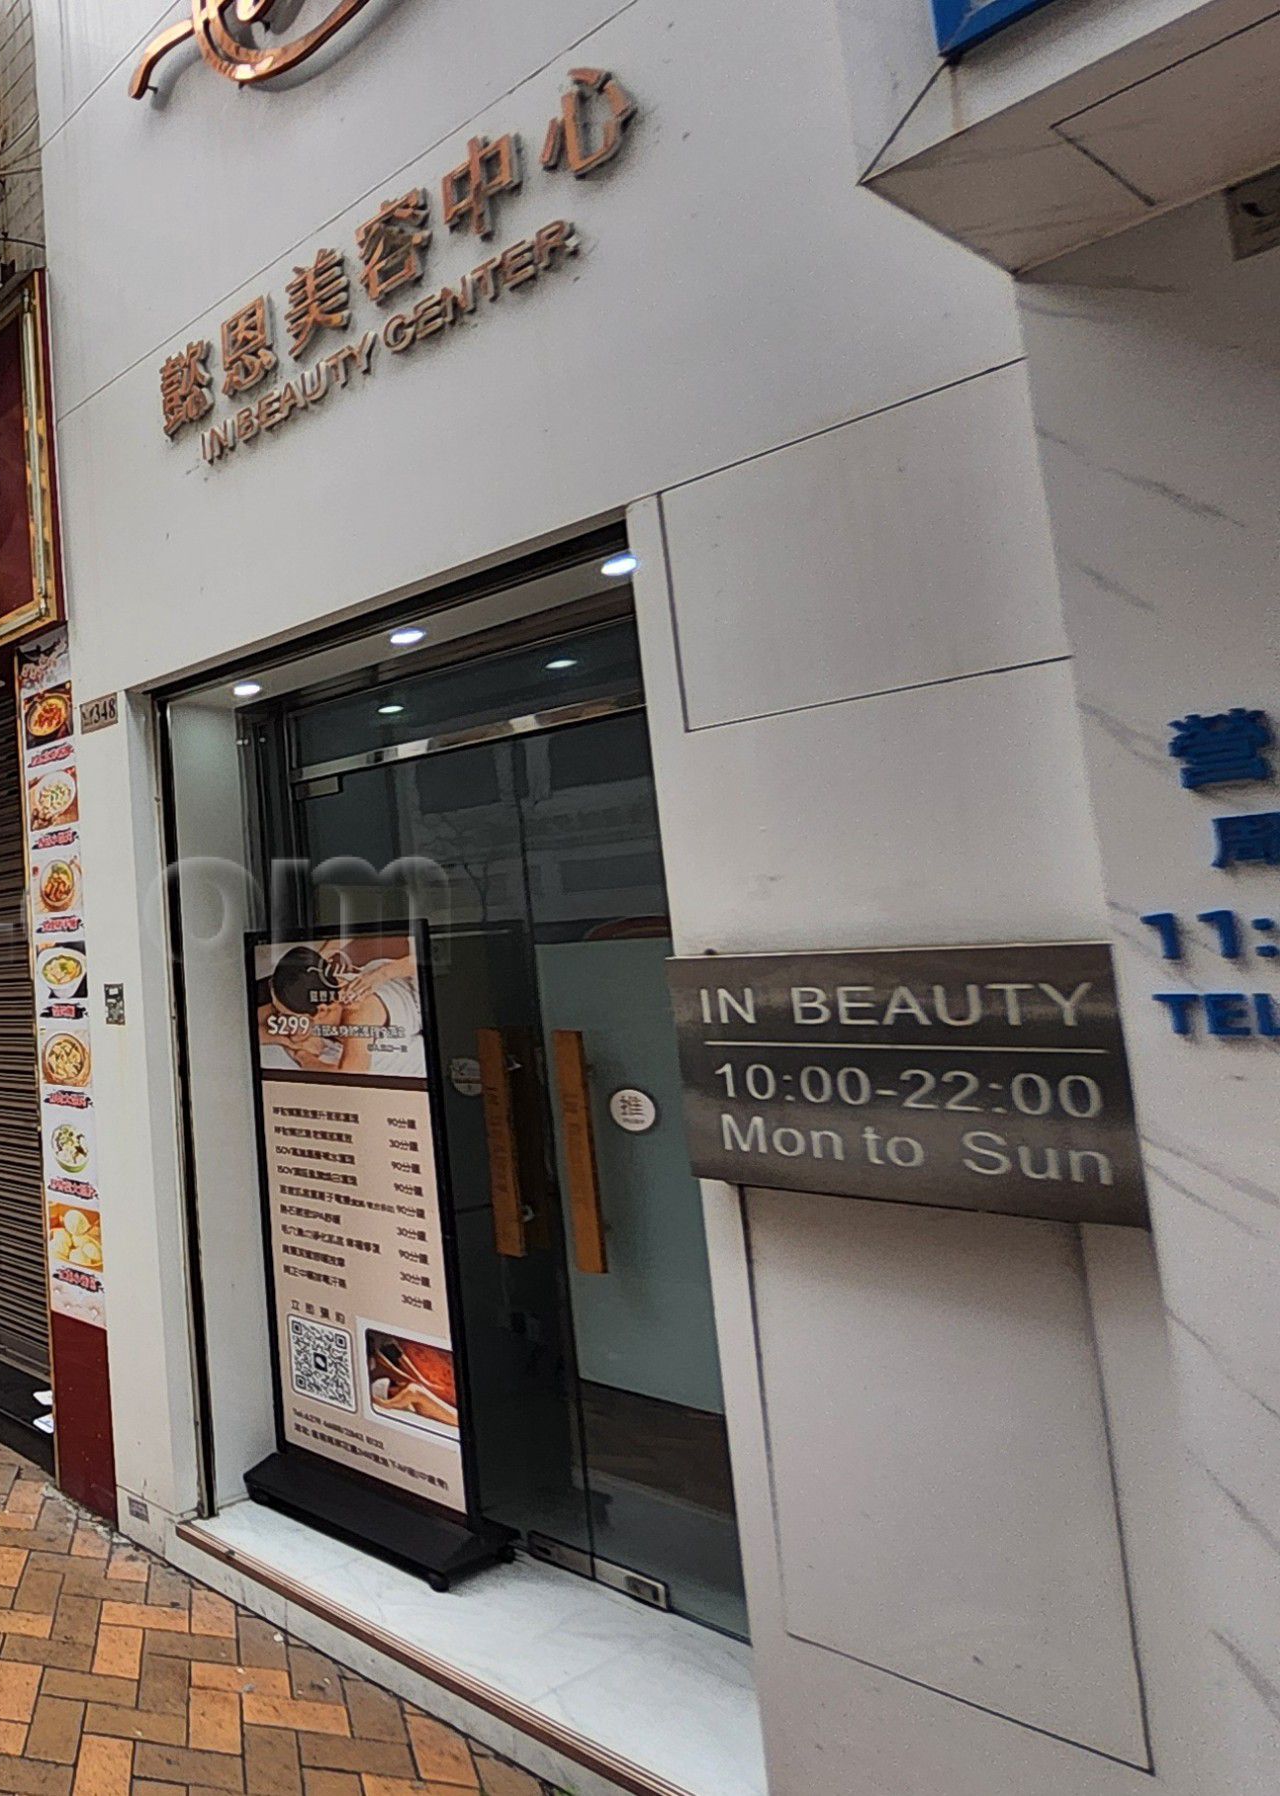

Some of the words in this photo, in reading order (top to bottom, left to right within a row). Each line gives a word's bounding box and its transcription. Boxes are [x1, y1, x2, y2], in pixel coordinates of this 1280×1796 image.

[699, 987, 757, 1024] IN
[790, 982, 1093, 1027] BEAUTY
[714, 1062, 1104, 1119] 10:00-22:00
[721, 1113, 846, 1161] Mon
[862, 1126, 926, 1168] to
[960, 1130, 1115, 1187] Sun
